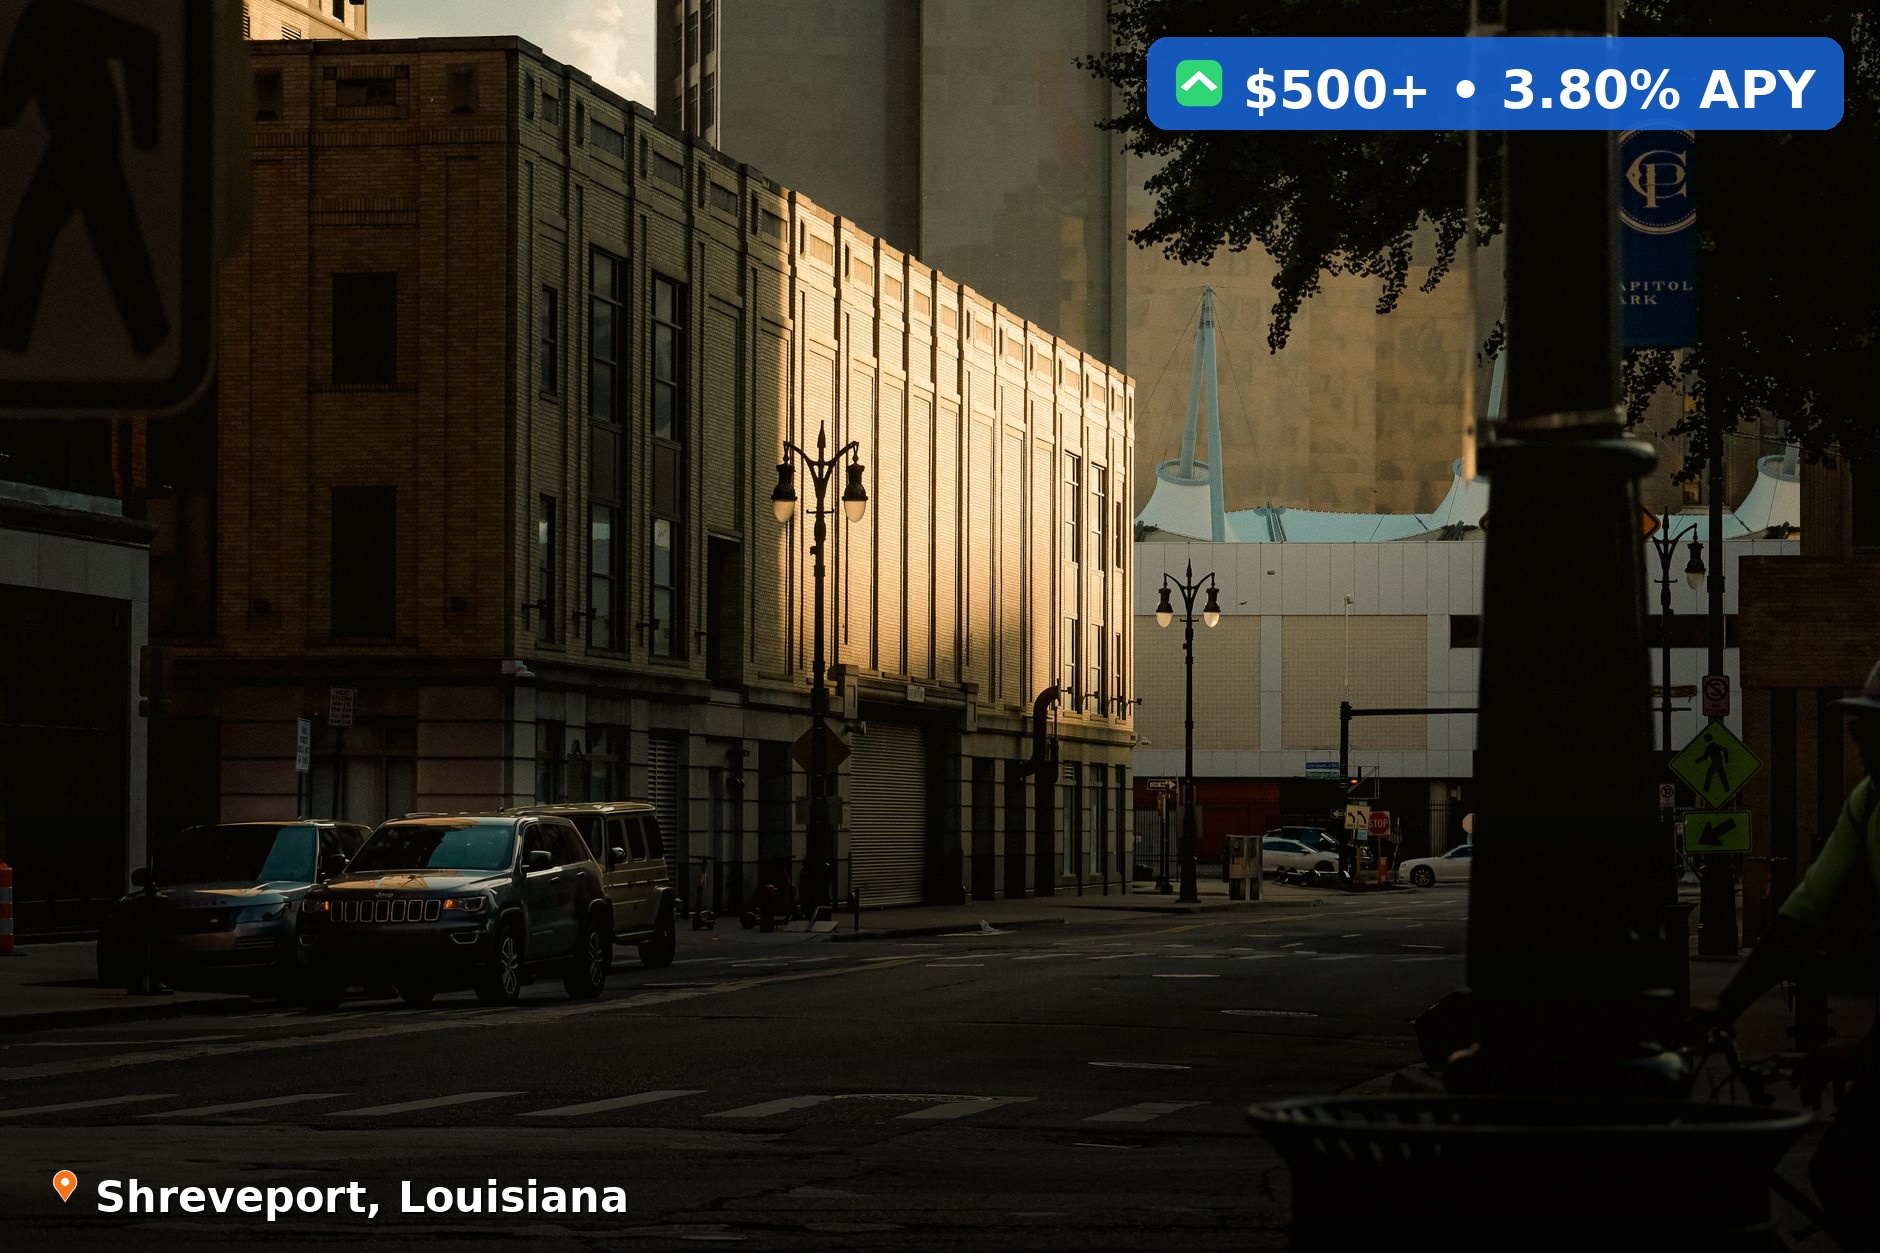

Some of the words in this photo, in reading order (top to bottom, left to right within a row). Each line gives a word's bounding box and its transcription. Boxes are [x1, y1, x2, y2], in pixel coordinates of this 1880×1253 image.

[1618, 281, 1692, 292] APITOL
[1618, 295, 1657, 305] ARK
[1369, 819, 1388, 828] STOP
